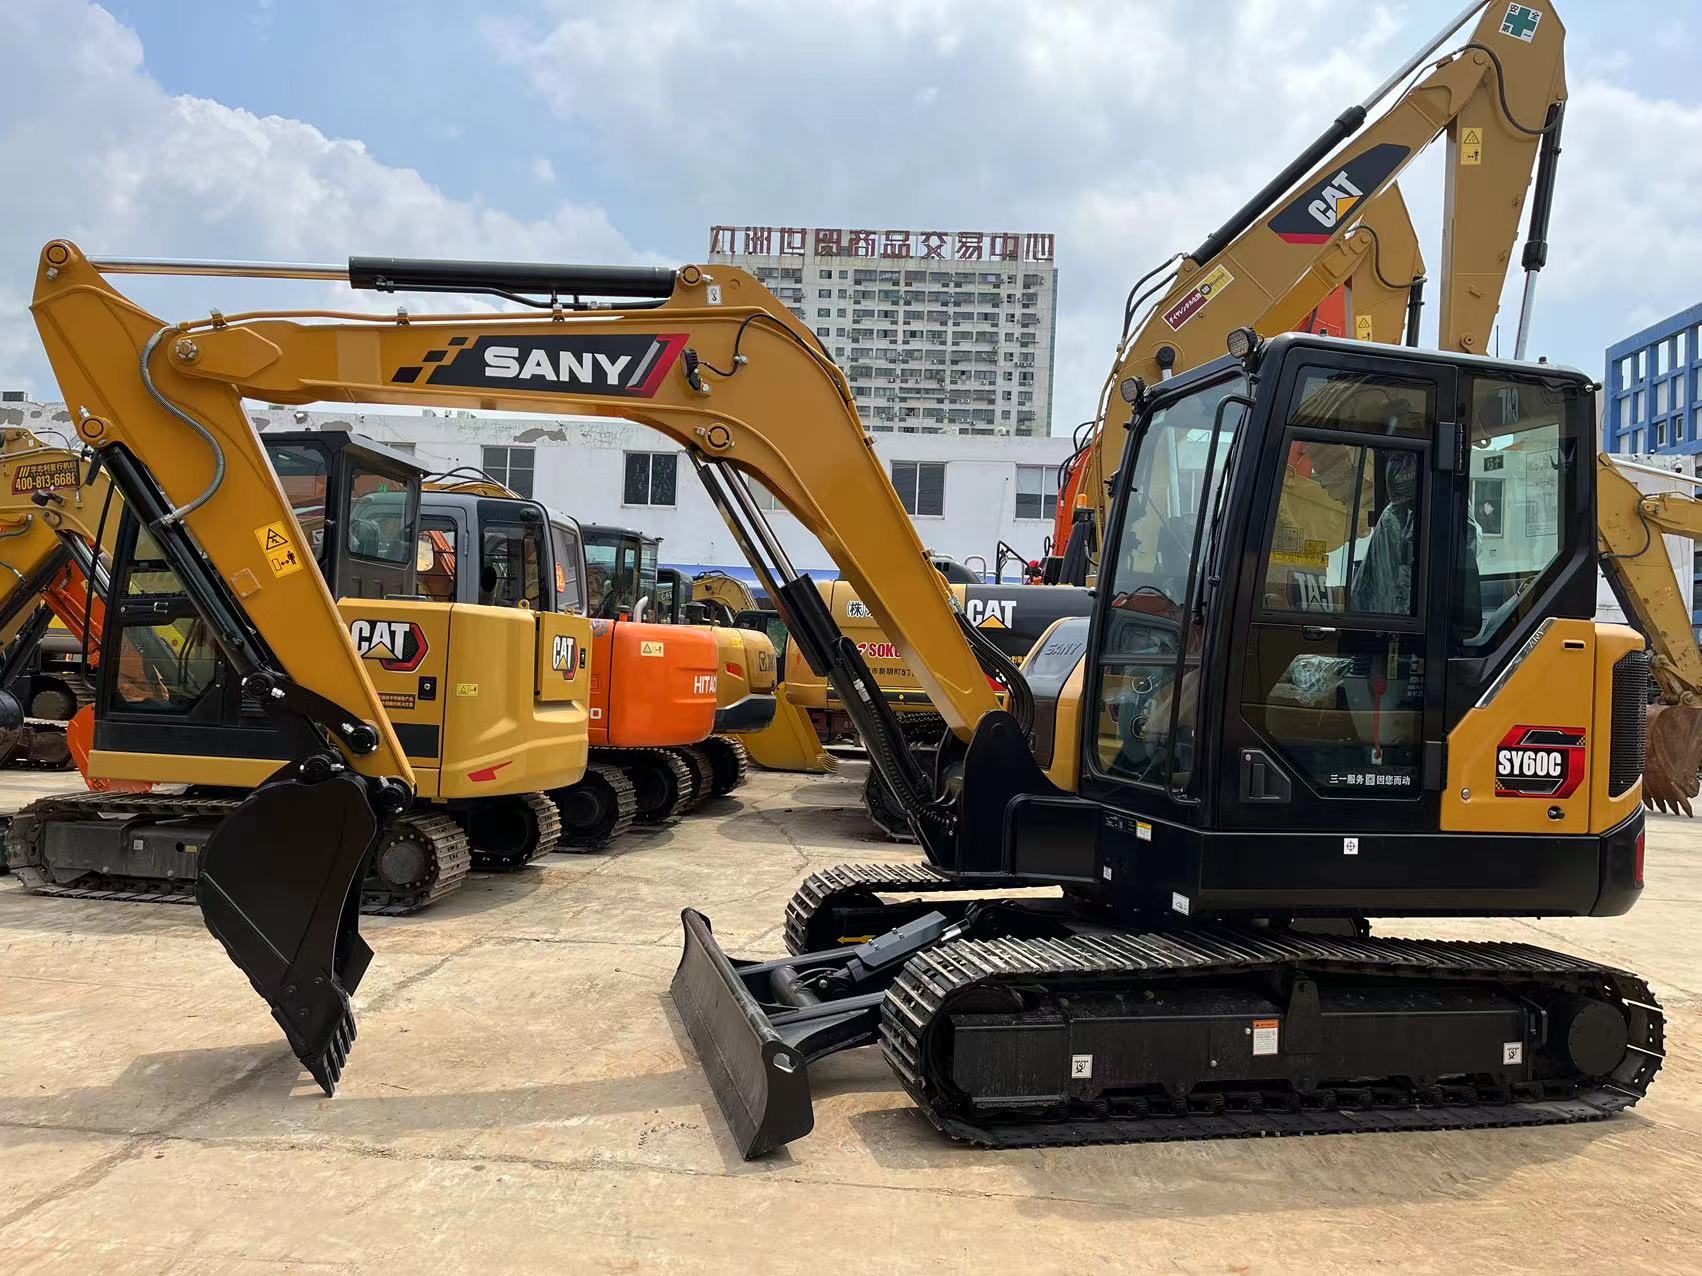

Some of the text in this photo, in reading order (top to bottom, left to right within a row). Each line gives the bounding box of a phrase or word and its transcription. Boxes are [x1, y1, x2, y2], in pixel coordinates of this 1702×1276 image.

[1308, 170, 1364, 228] CAT
[484, 346, 632, 385] SANY
[967, 599, 1017, 629] CAT
[351, 620, 410, 660] CAT
[552, 635, 574, 670] CAT
[1045, 642, 1082, 656] SANY
[1498, 749, 1562, 777] SY60C
[1329, 774, 1411, 786] 三一服务 因您而动
